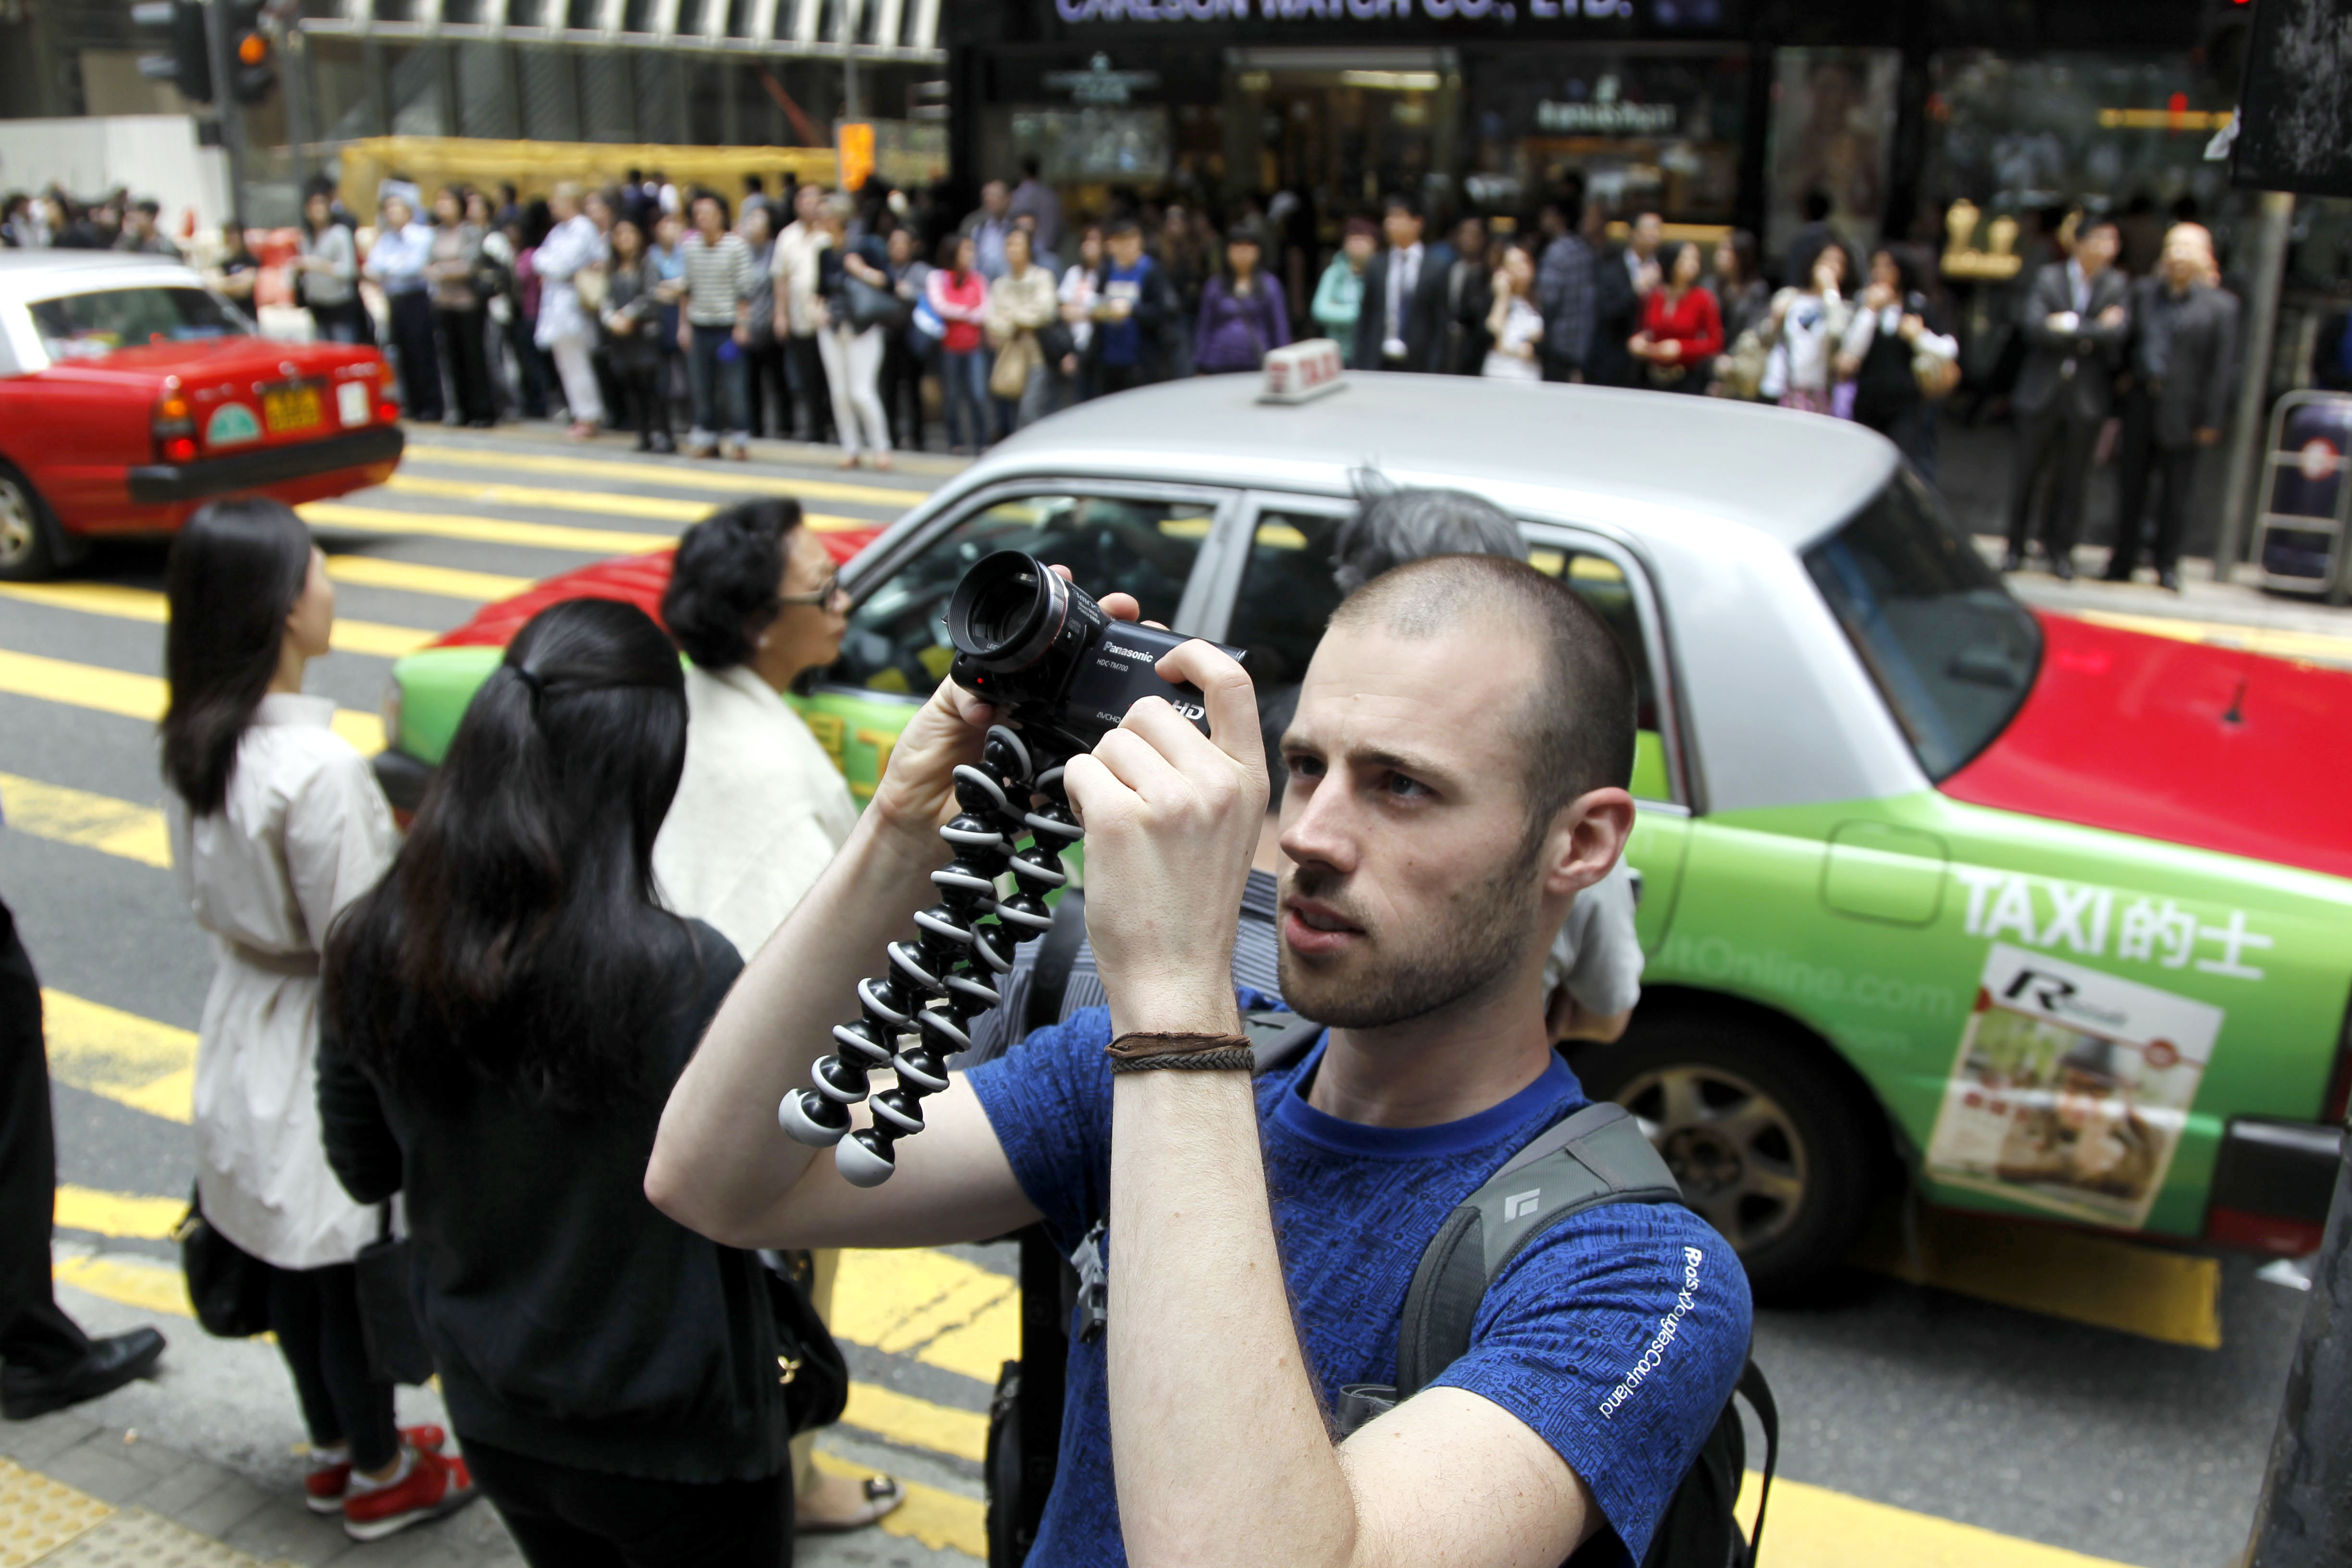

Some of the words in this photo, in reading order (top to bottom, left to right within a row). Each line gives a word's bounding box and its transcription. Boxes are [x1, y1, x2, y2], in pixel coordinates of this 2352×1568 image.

[1103, 641, 1153, 662] Panasonic
[1097, 659, 1128, 672] HDC-TM700
[1097, 711, 1121, 723] AVCHD
[1172, 699, 1205, 720] HD
[1957, 868, 2114, 956] TAXI
[2119, 896, 2275, 980] 的士
